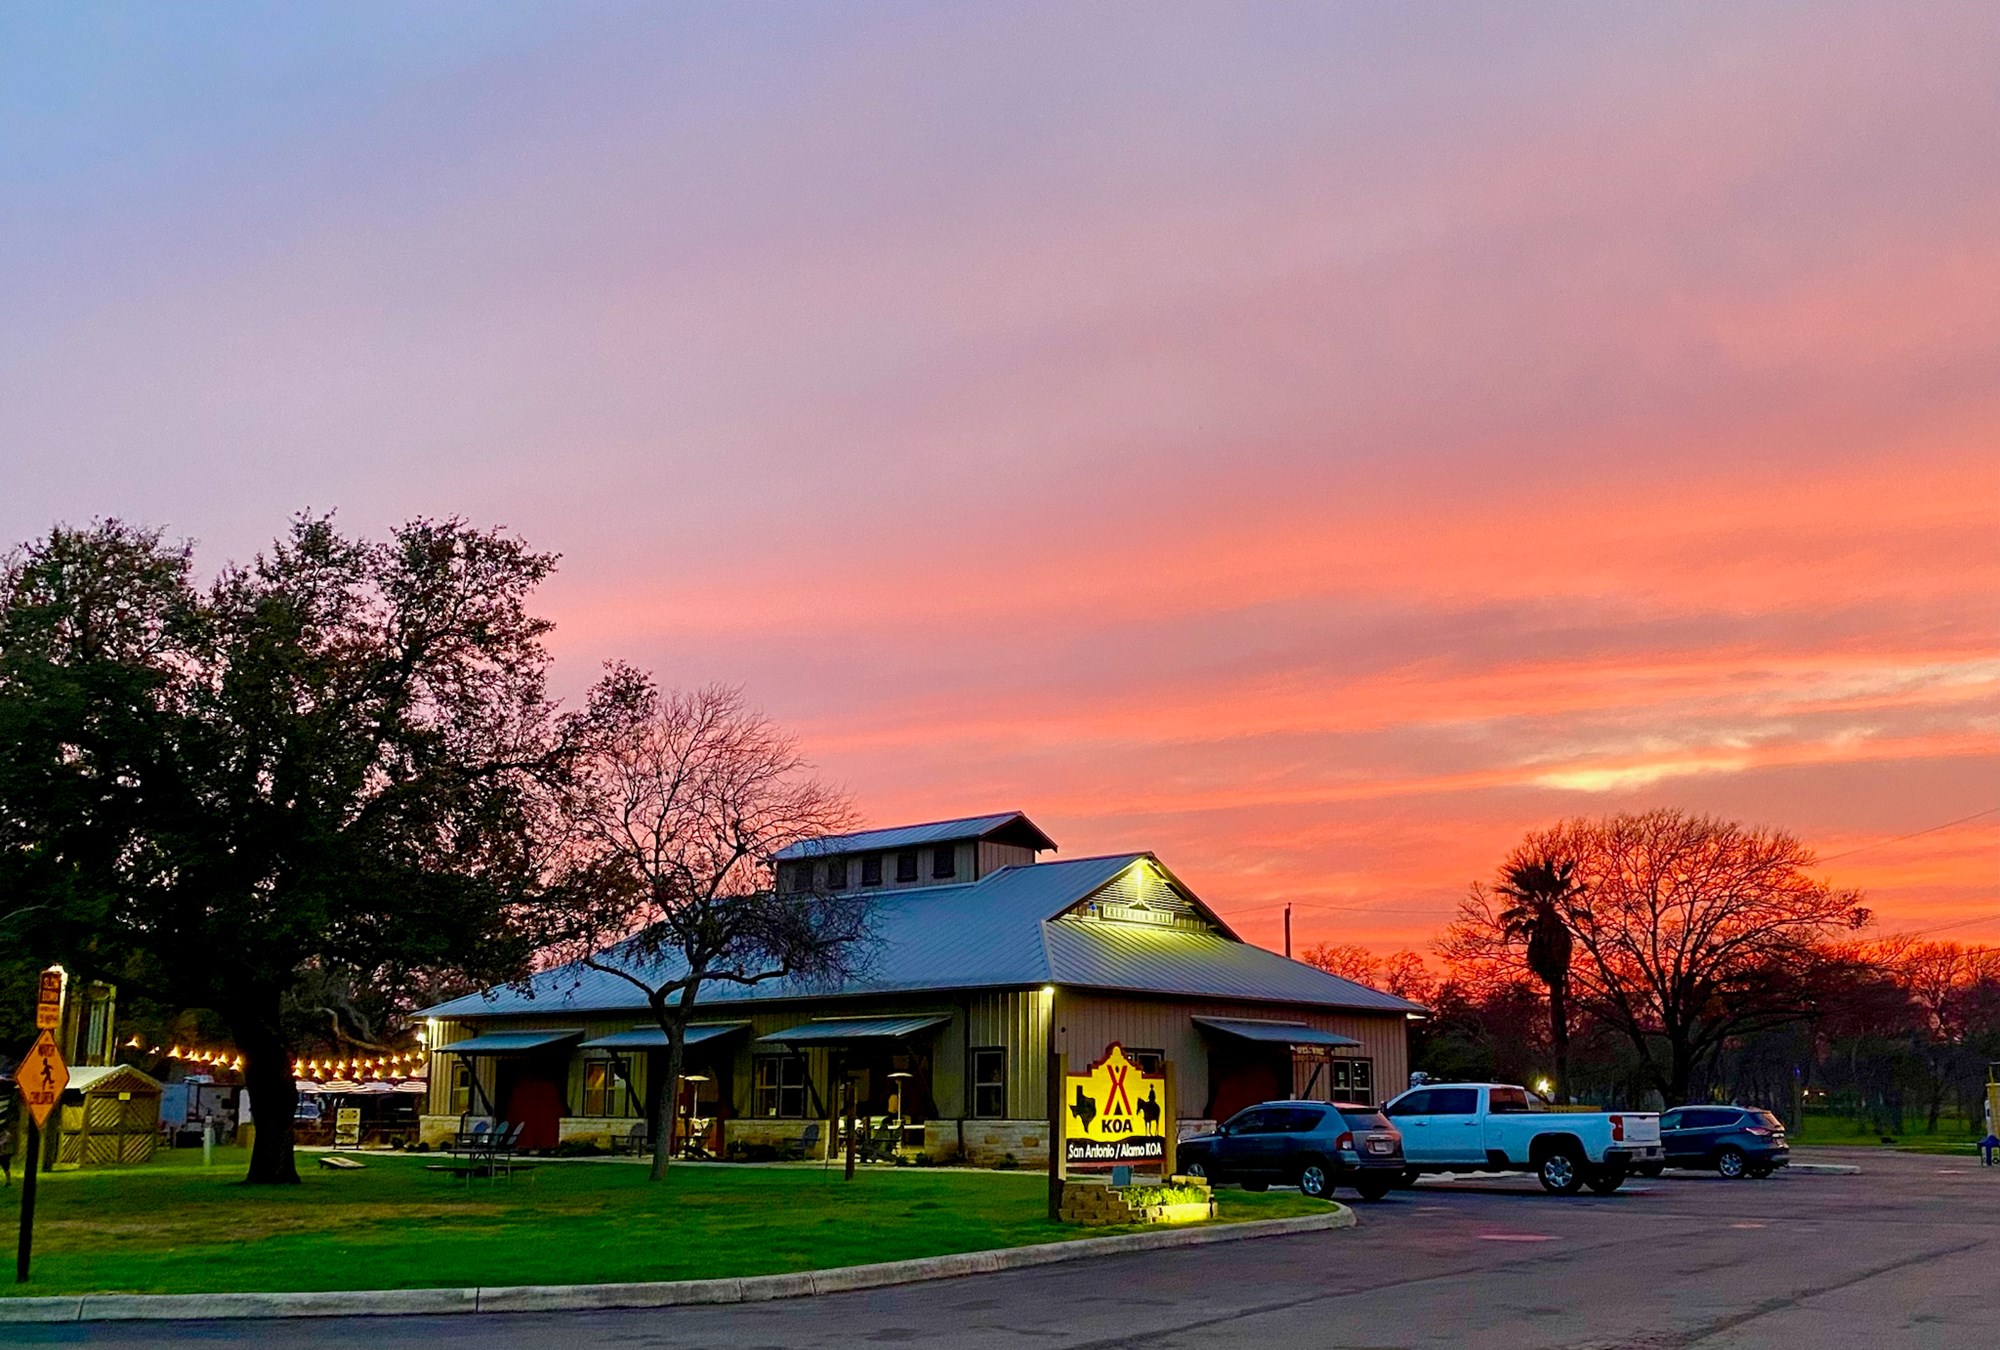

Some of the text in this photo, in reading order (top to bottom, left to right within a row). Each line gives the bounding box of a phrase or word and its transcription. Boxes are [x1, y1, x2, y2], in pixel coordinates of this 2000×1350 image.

[1153, 912, 1172, 924] HALL
[1101, 1118, 1133, 1134] KOA
[1068, 1142, 1162, 1160] San Antonio / Alamo KOA
